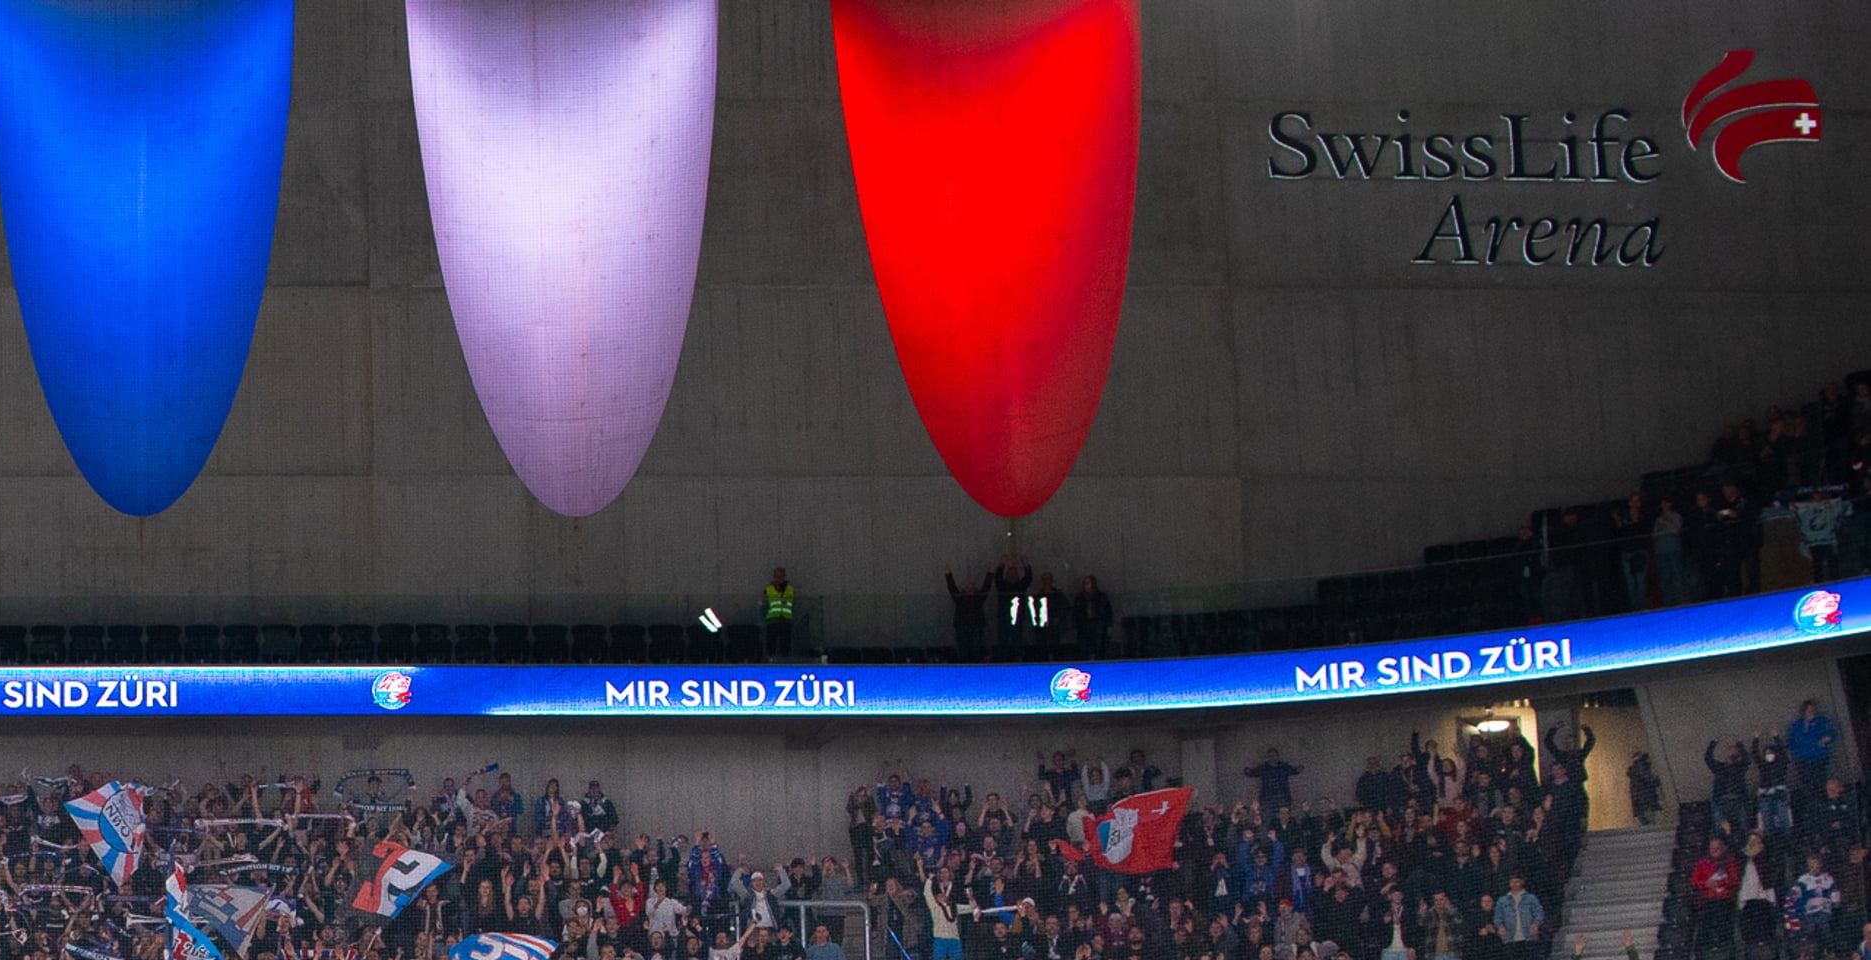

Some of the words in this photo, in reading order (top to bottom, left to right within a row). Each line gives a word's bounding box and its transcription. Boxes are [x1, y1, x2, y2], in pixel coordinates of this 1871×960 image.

[1268, 109, 1662, 183] SwissLife
[1411, 194, 1665, 267] Arena
[2, 681, 89, 708] SIND
[95, 675, 178, 708] ZÜRI
[605, 680, 670, 707] MIR
[681, 680, 766, 707] SIND
[774, 674, 855, 707] ZÜRI
[1295, 660, 1365, 692] MIR
[1377, 651, 1472, 686] SIND
[1479, 638, 1572, 676] ZÜRI
